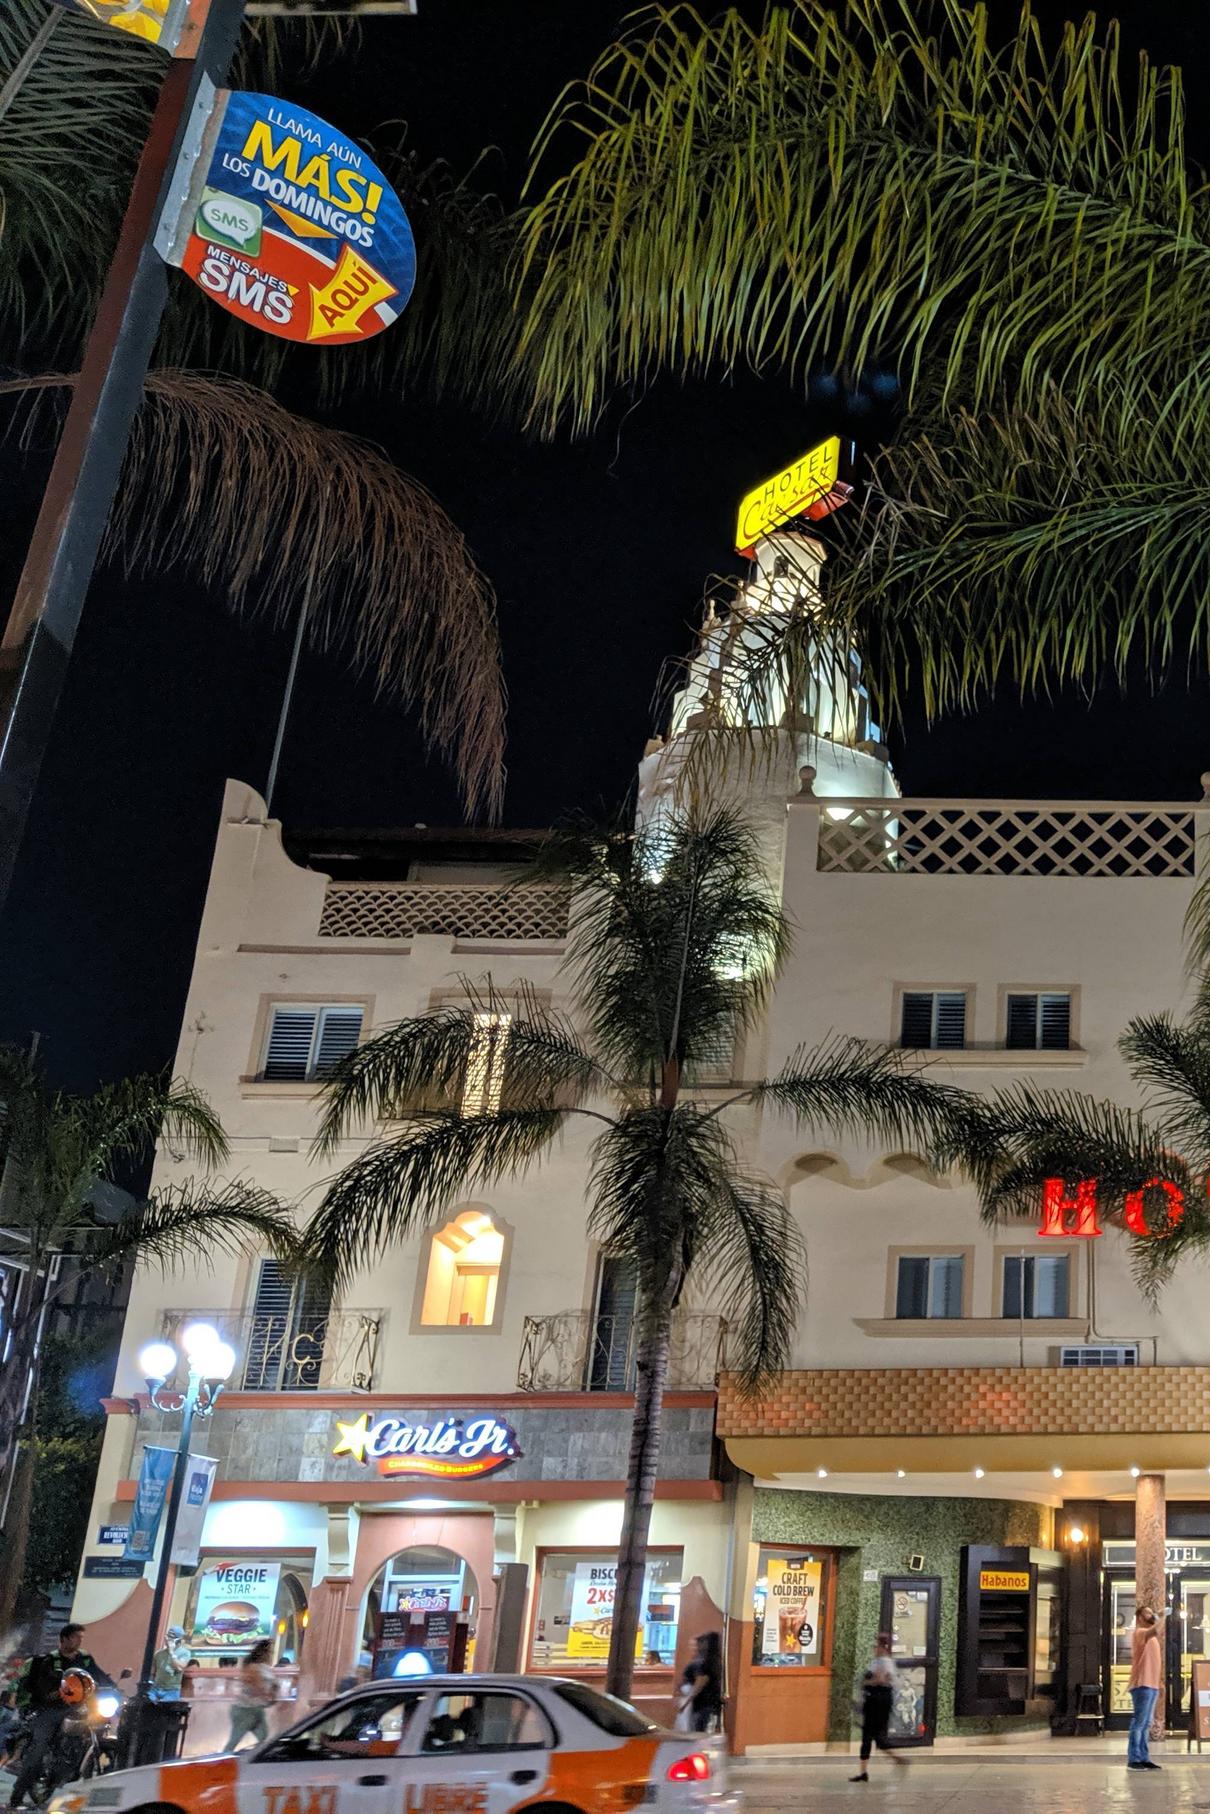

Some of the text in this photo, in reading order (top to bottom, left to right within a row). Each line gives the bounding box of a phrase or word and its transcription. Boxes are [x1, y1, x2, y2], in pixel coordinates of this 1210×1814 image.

[267, 108, 362, 169] LLAMA AÚN
[242, 120, 384, 226] MÁS!
[222, 153, 375, 248] LOS DOMINGOS
[210, 208, 249, 232] SMS
[207, 245, 288, 293] MENSAJES
[200, 258, 294, 324] SMS
[318, 260, 379, 328] AQUÍ
[764, 446, 833, 500] HOTEL
[365, 1417, 515, 1458] Carl's Jr.
[1164, 1547, 1203, 1561] OTEL
[216, 1568, 268, 1583] VEGGIE
[226, 1583, 252, 1594] STAR
[590, 1568, 617, 1580] BISC
[781, 1572, 808, 1585] CRAFT
[981, 1574, 1028, 1588] Habanos
[772, 1585, 815, 1597] COLD BREW
[262, 1782, 489, 1814] TAXI LIBRE
